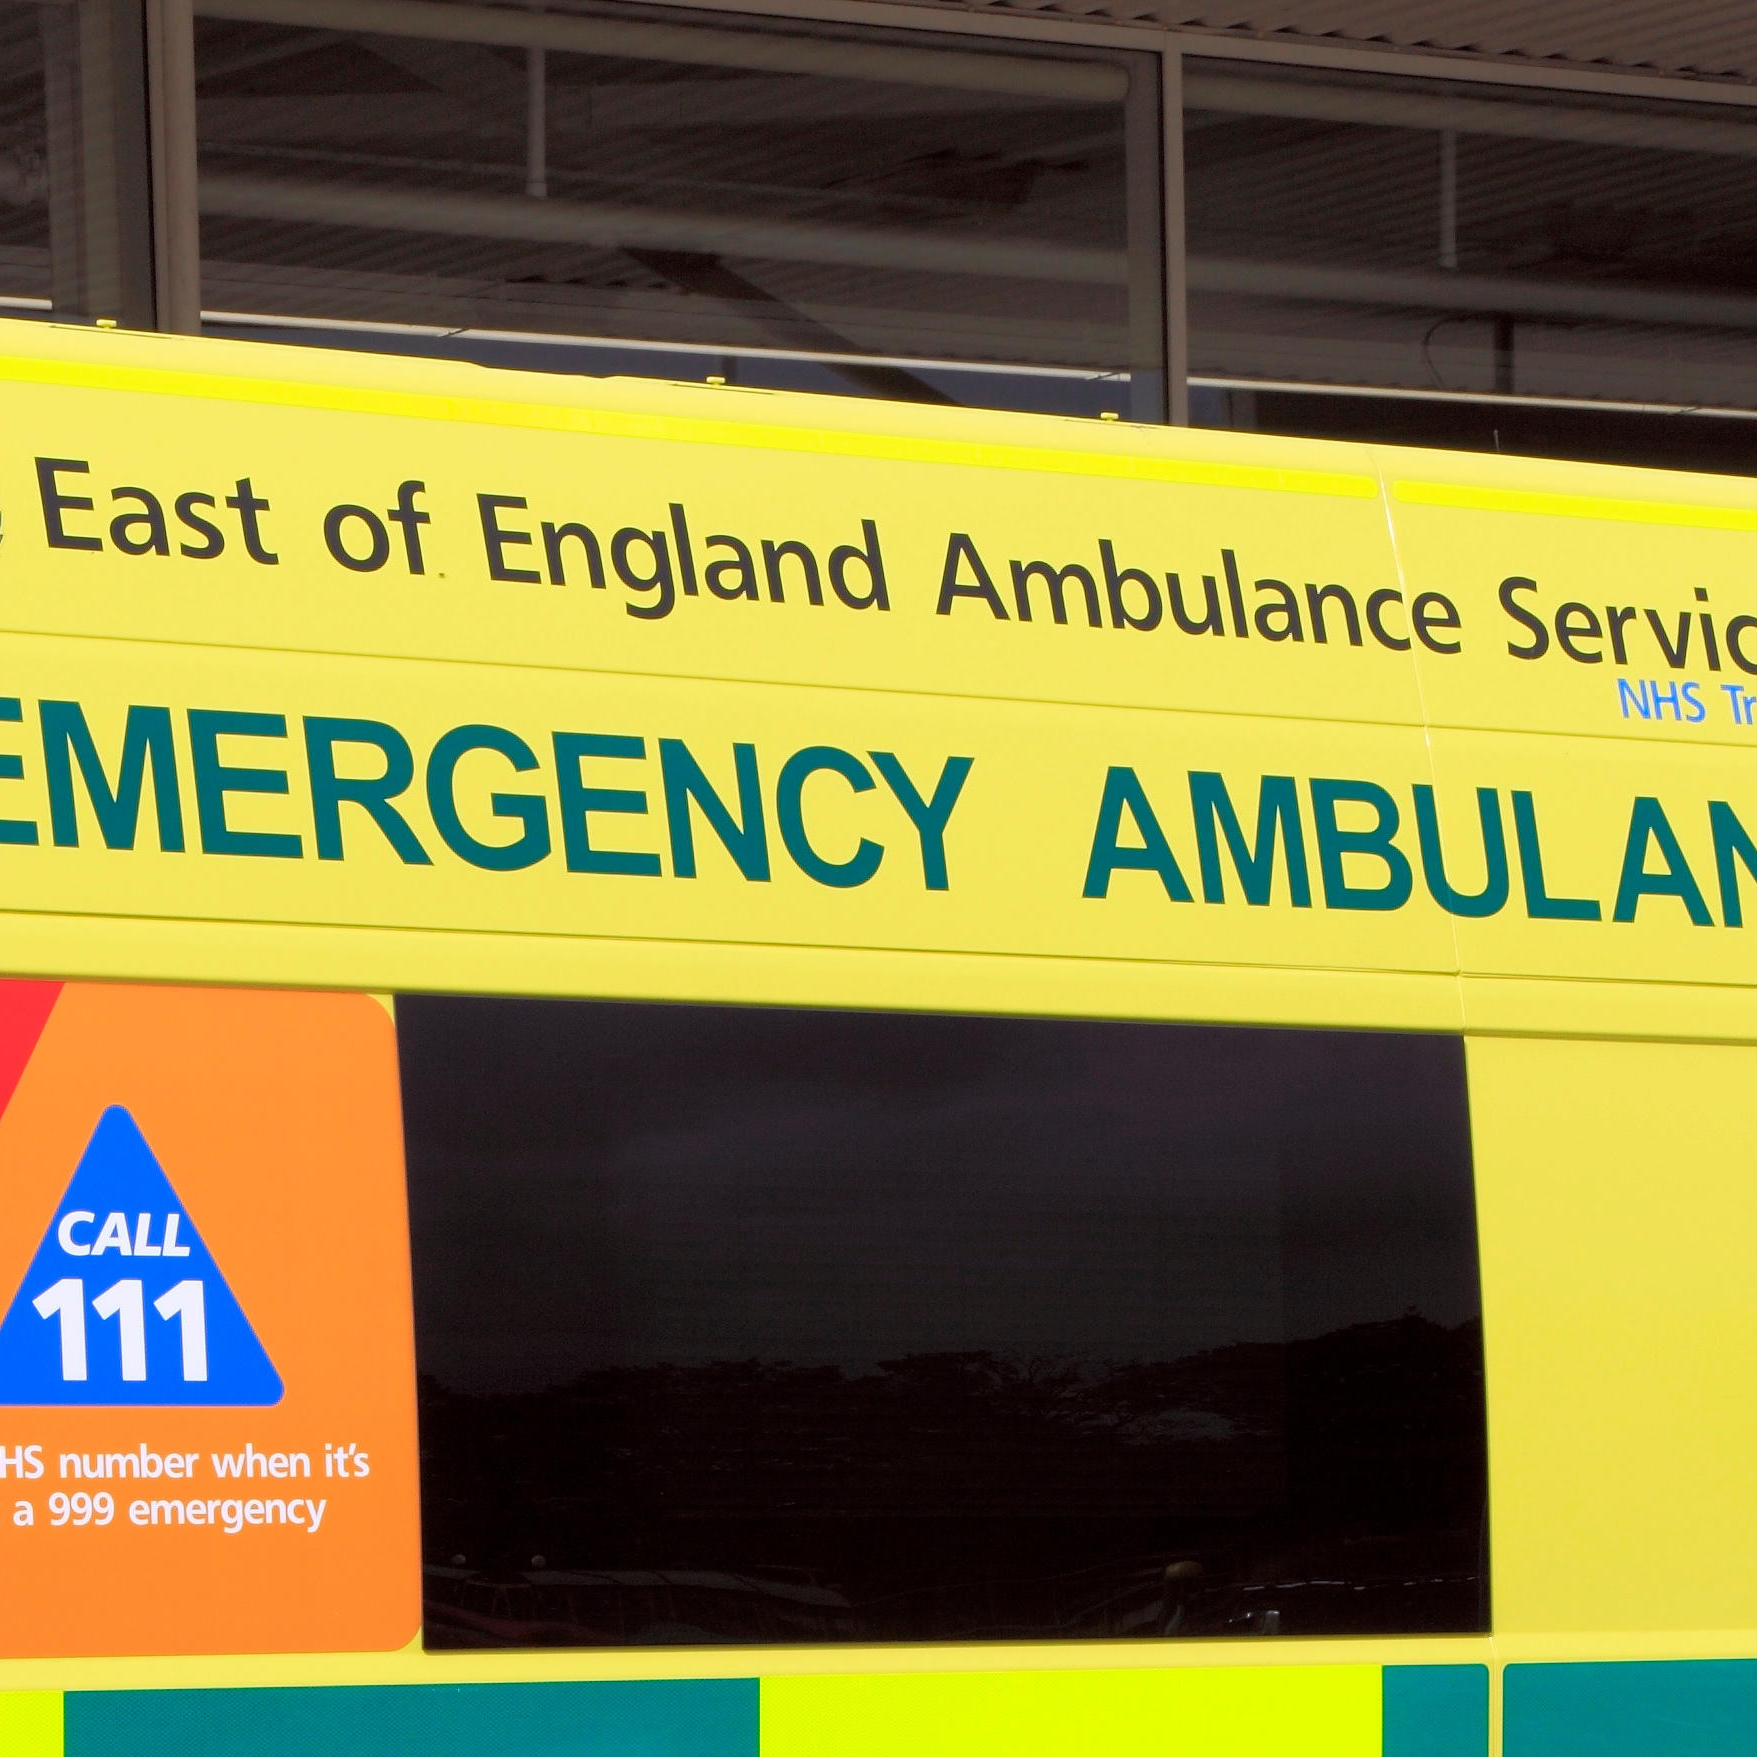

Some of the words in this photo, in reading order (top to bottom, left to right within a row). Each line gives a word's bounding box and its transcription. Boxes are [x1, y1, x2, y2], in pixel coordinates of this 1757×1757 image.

[34, 456, 278, 566] East
[323, 479, 430, 575] of
[477, 493, 891, 620] England
[935, 533, 1462, 654] Ambulance
[1617, 678, 1706, 723] NHS
[57, 1210, 191, 1257] CALL
[32, 1277, 208, 1382] 111
[59, 1443, 199, 1479] number
[211, 1443, 311, 1478] when
[325, 1443, 371, 1478] it's
[13, 1500, 35, 1527] a
[48, 1491, 115, 1526] 999
[129, 1496, 327, 1534] emergency
